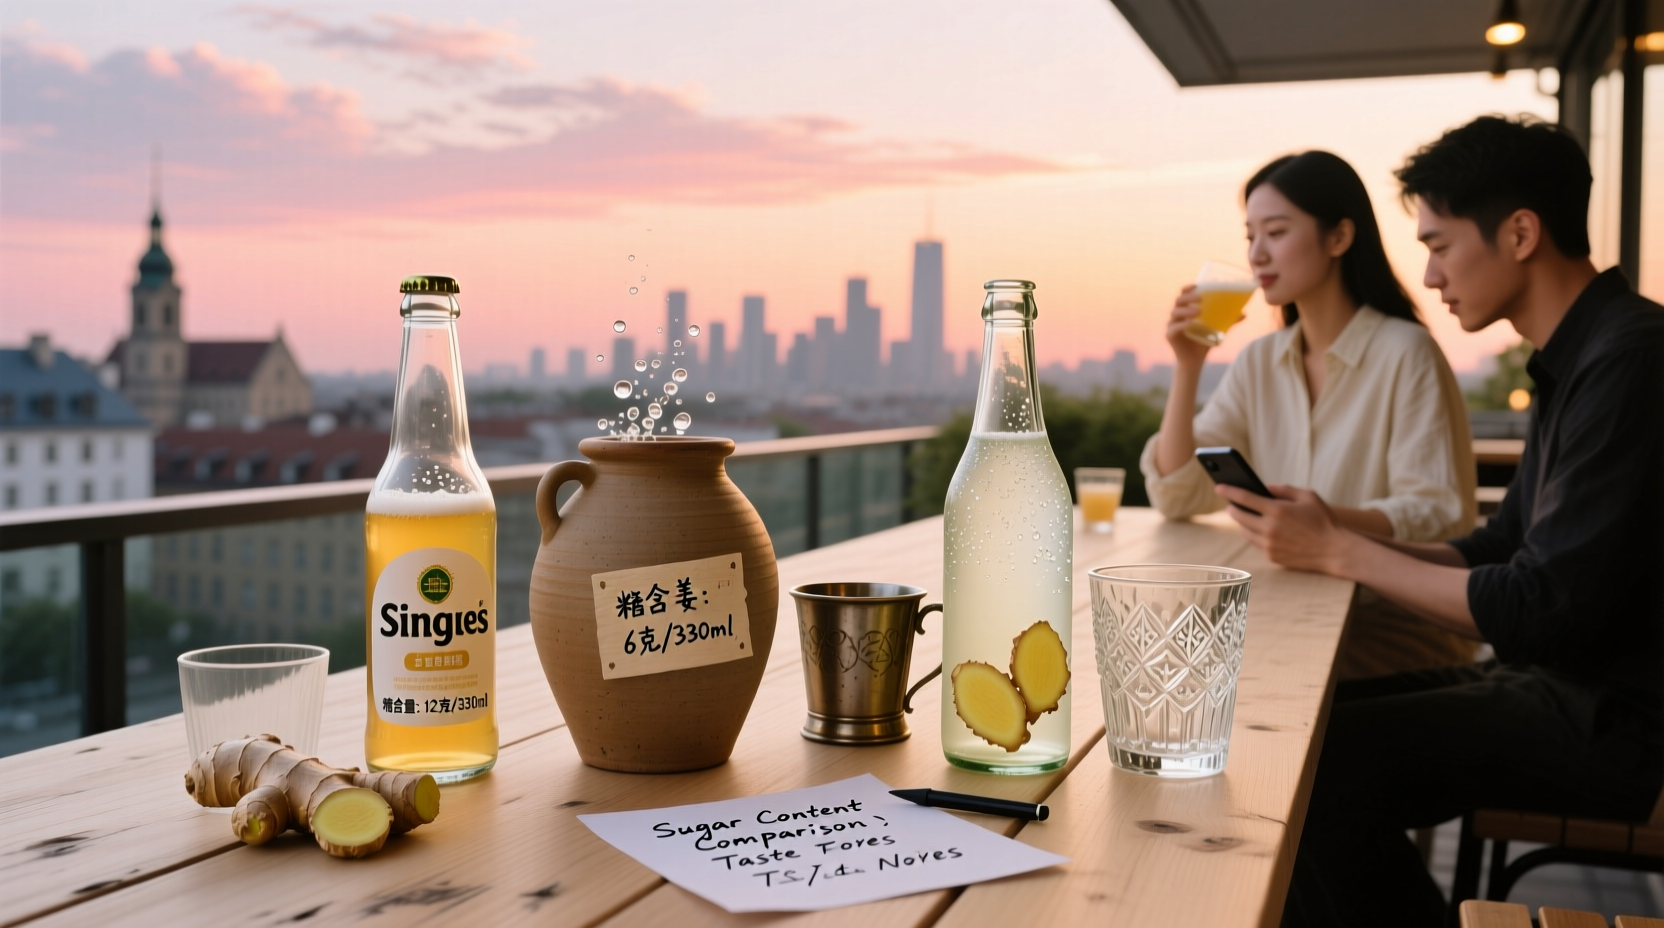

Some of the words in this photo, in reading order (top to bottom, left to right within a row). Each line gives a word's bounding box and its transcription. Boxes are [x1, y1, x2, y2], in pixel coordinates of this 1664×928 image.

[624, 613, 733, 656] 6克/330ml
[652, 818, 742, 840] Sugar
[756, 799, 862, 824] Content
[711, 849, 801, 870] Taste
